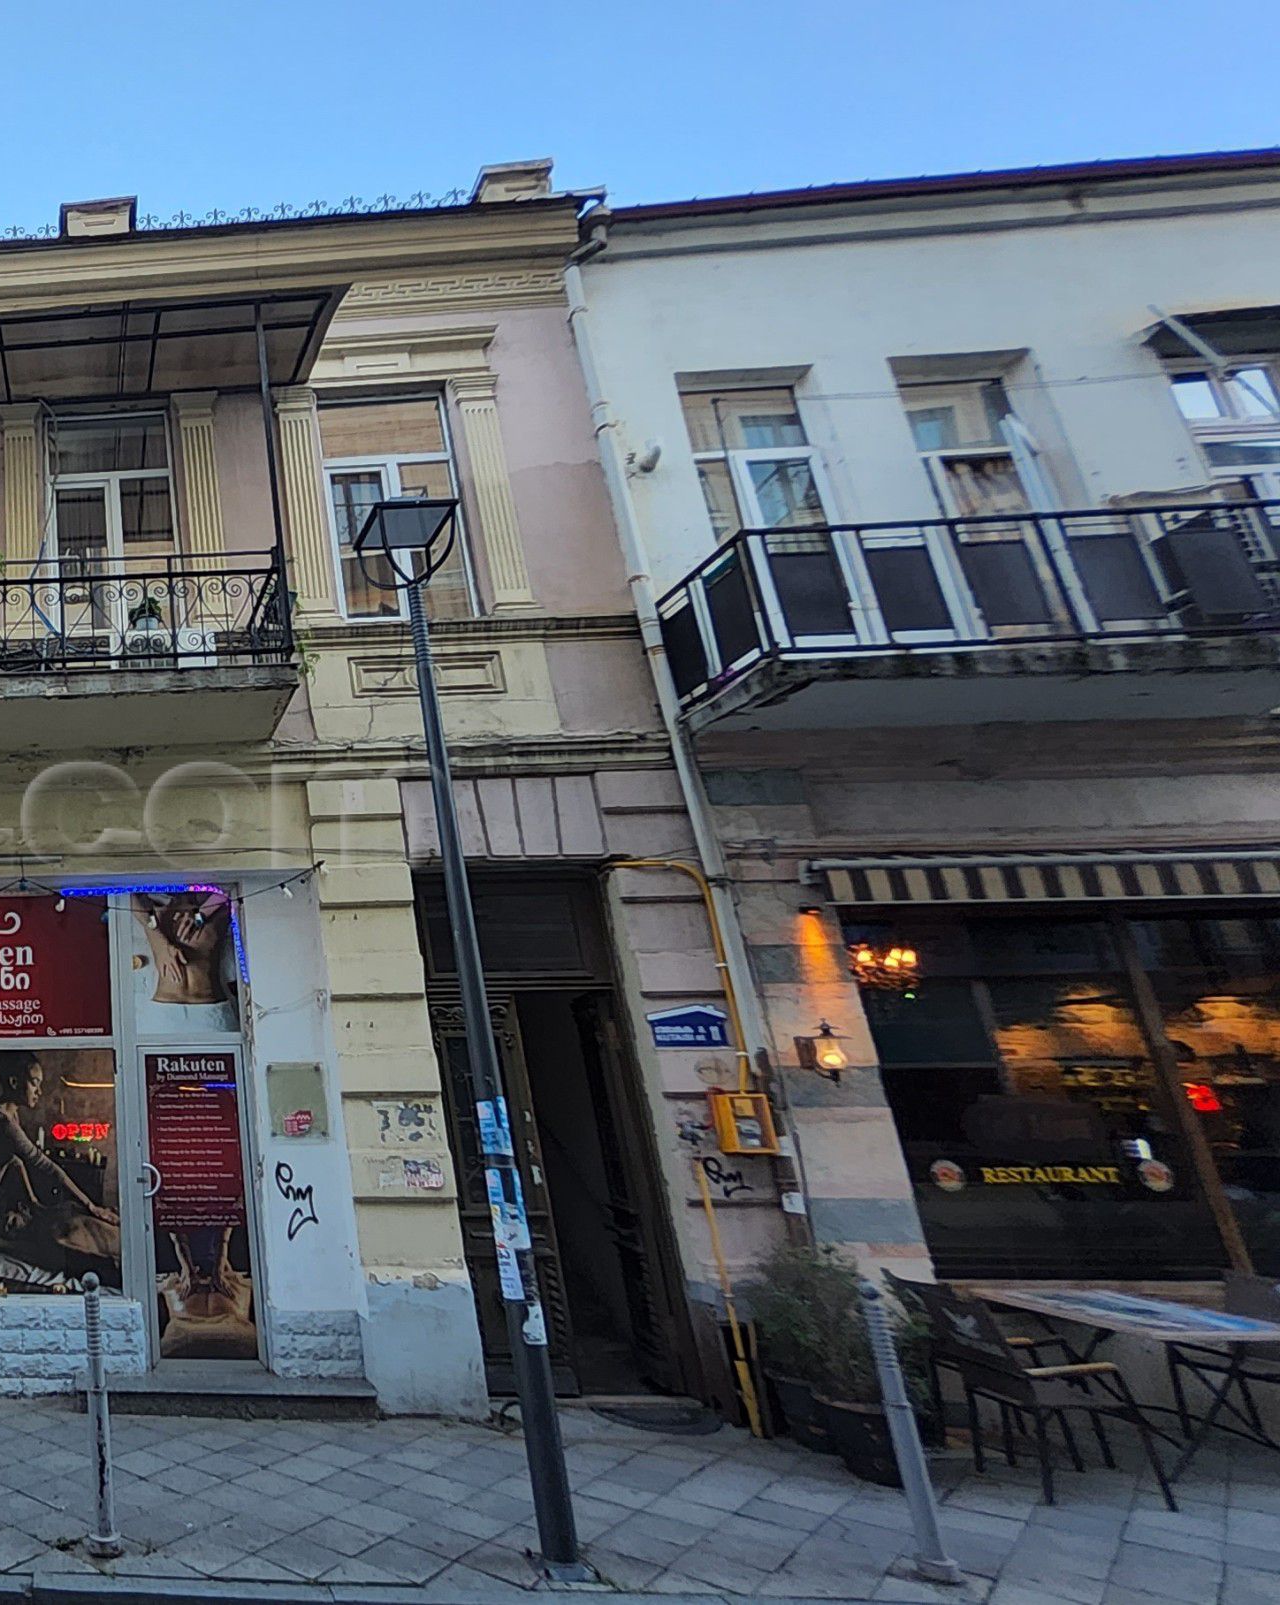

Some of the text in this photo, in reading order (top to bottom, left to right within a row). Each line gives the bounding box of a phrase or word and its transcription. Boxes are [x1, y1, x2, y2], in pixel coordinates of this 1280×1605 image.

[157, 1057, 226, 1073] Rakuten
[167, 1073, 198, 1081] Diamond
[52, 1123, 110, 1140] OPEN
[980, 1166, 1120, 1184] RESTAURANT
